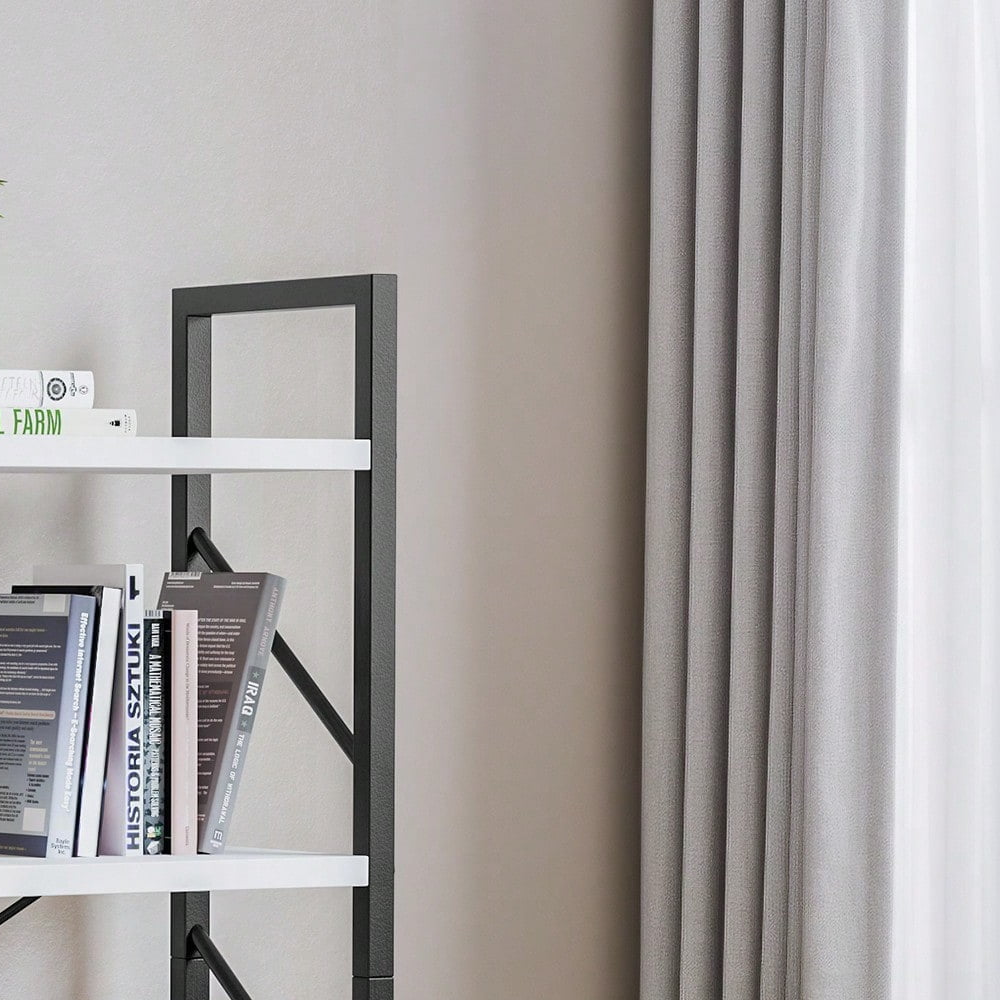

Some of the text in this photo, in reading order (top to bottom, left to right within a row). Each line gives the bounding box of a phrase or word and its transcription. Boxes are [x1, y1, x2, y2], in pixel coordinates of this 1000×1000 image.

[13, 408, 62, 435] FARM
[266, 586, 279, 623] ANTHONY
[77, 611, 89, 648] Effective
[75, 649, 86, 681] Internet
[127, 623, 140, 719] SZTUKI
[72, 681, 82, 711] Search
[148, 661, 162, 716] MATHEMATICAL
[241, 681, 259, 716] IRAQ
[149, 716, 162, 744] MOSAIC
[236, 733, 246, 747] THE
[231, 749, 241, 770] LOGIC
[126, 726, 140, 850] HISTORIA
[230, 771, 236, 781] OF
